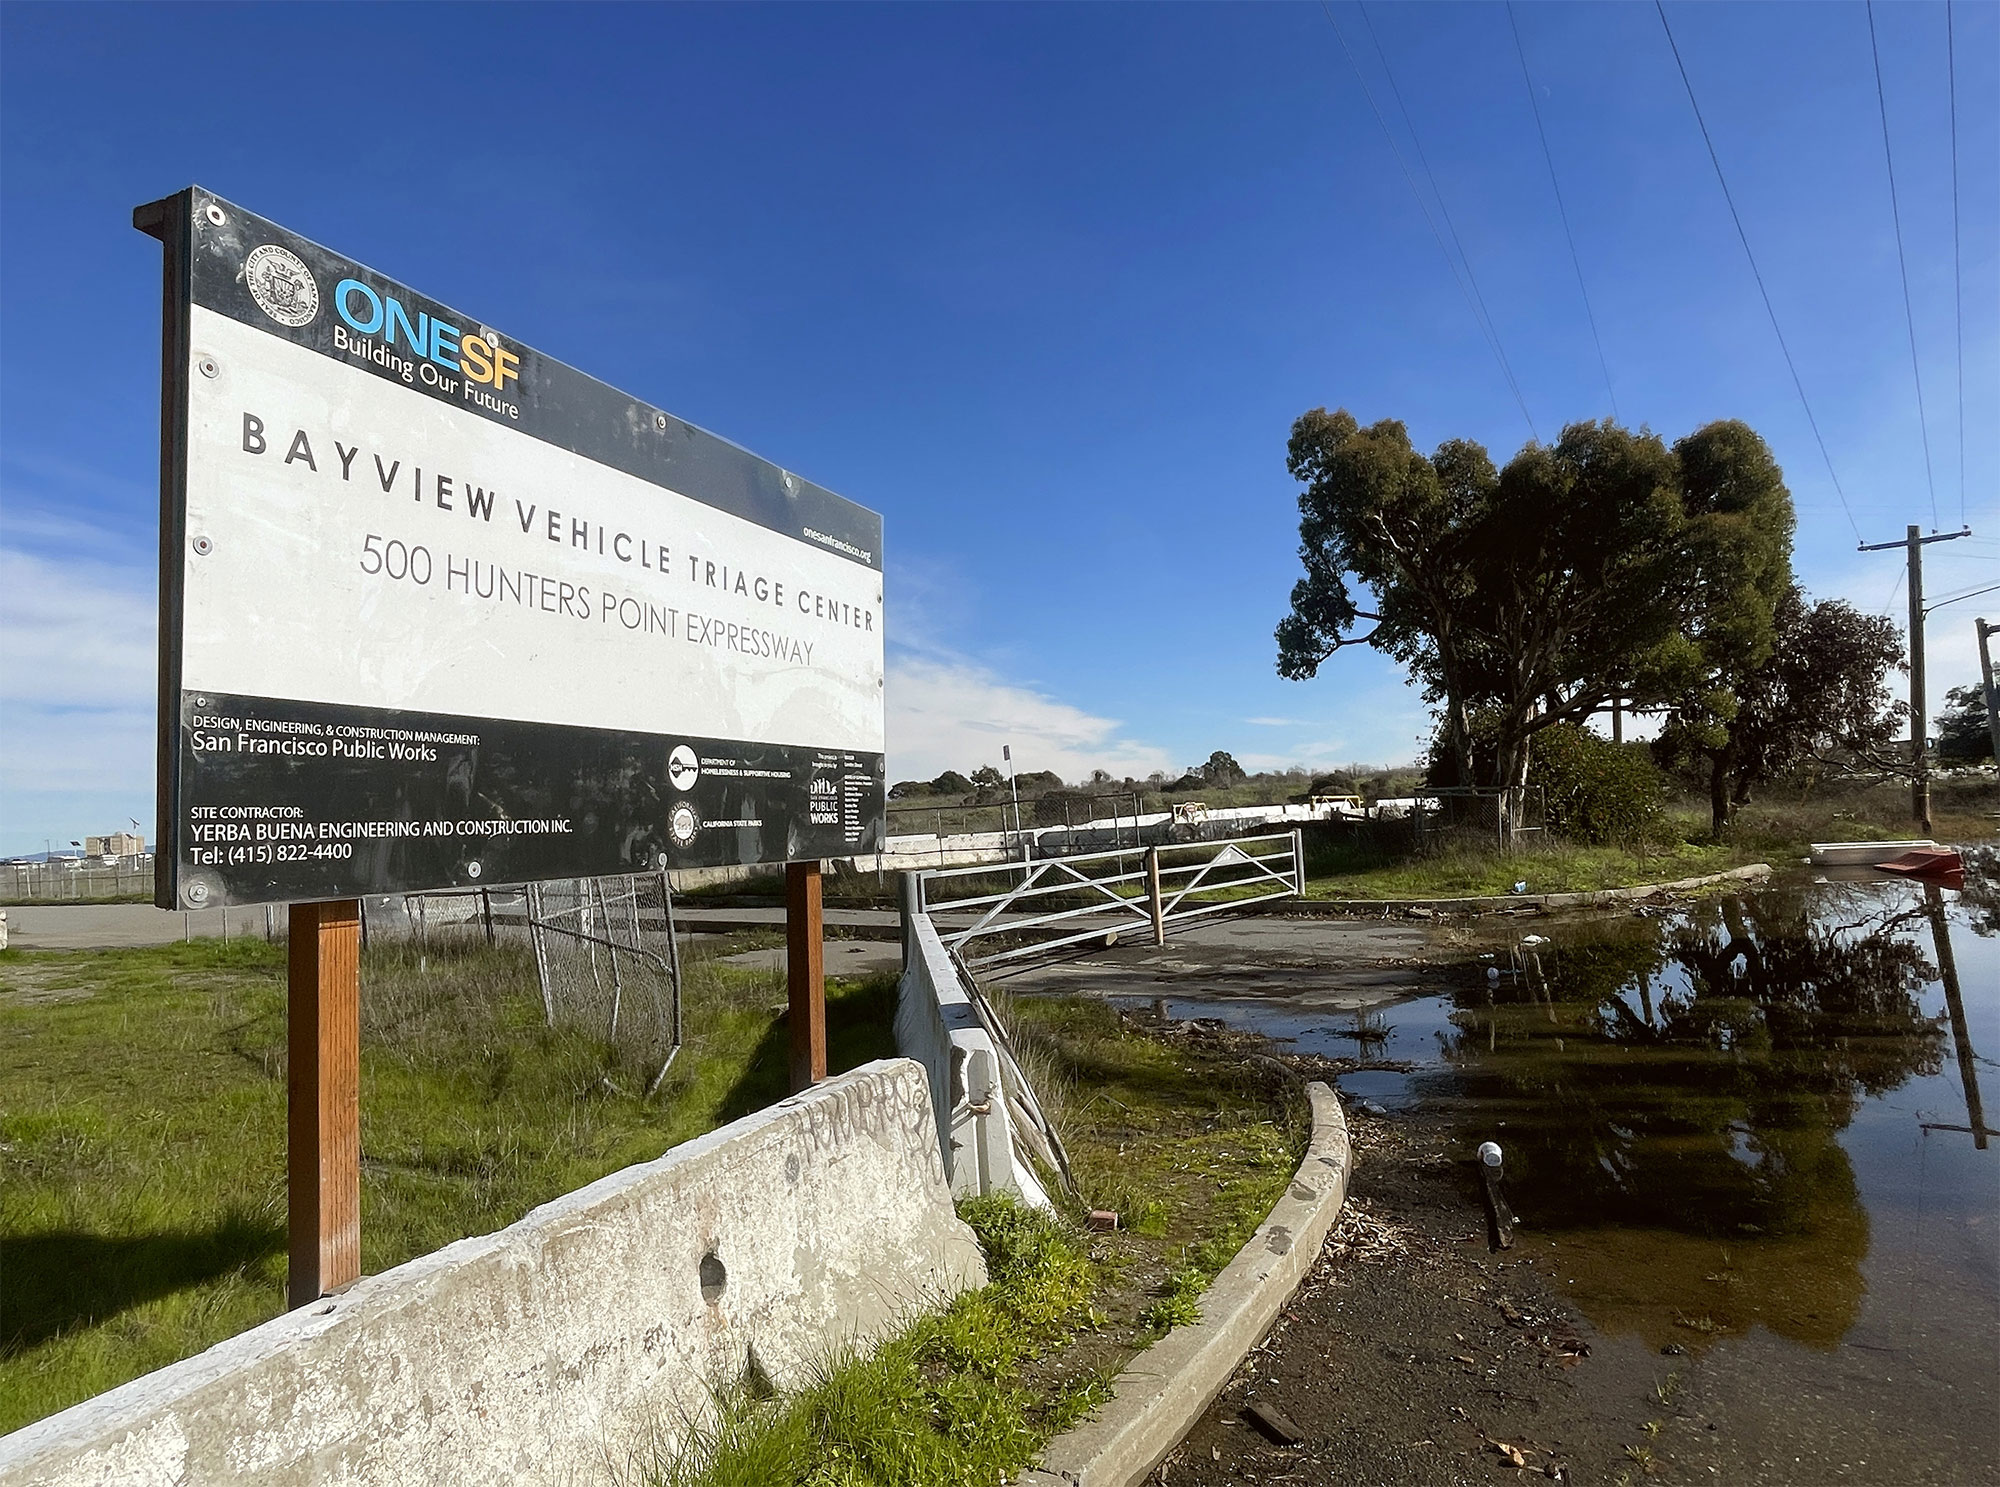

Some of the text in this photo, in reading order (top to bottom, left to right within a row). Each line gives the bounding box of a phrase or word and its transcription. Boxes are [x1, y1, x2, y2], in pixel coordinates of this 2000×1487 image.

[259, 247, 274, 255] AND
[274, 248, 305, 270] COUNTY
[334, 325, 520, 420] Building Our Future
[242, 411, 875, 633] BAYVIEW VEHICLE TRIAGE CENTER
[803, 526, 873, 564] onesanfrancisco.org
[359, 533, 814, 666] 500 HUNTERS POINT EXPRESSWAY
[192, 715, 481, 746] DESIGN, ENGINEERING, & CONSTRUCTION MANAGEMENT:
[192, 731, 437, 762] San Francisco Public Works
[743, 770, 770, 778] SUPPORTIVE
[191, 806, 304, 820] SITE CONTRACTOR:
[810, 801, 839, 812] PUBLIC
[733, 820, 747, 828] STATE
[810, 813, 839, 824] WORKS
[191, 819, 574, 842] YERBA BUENA ENGINEERING AND CONSTRUCTION INC.
[190, 843, 353, 867] Tel: (415) 822-4400
